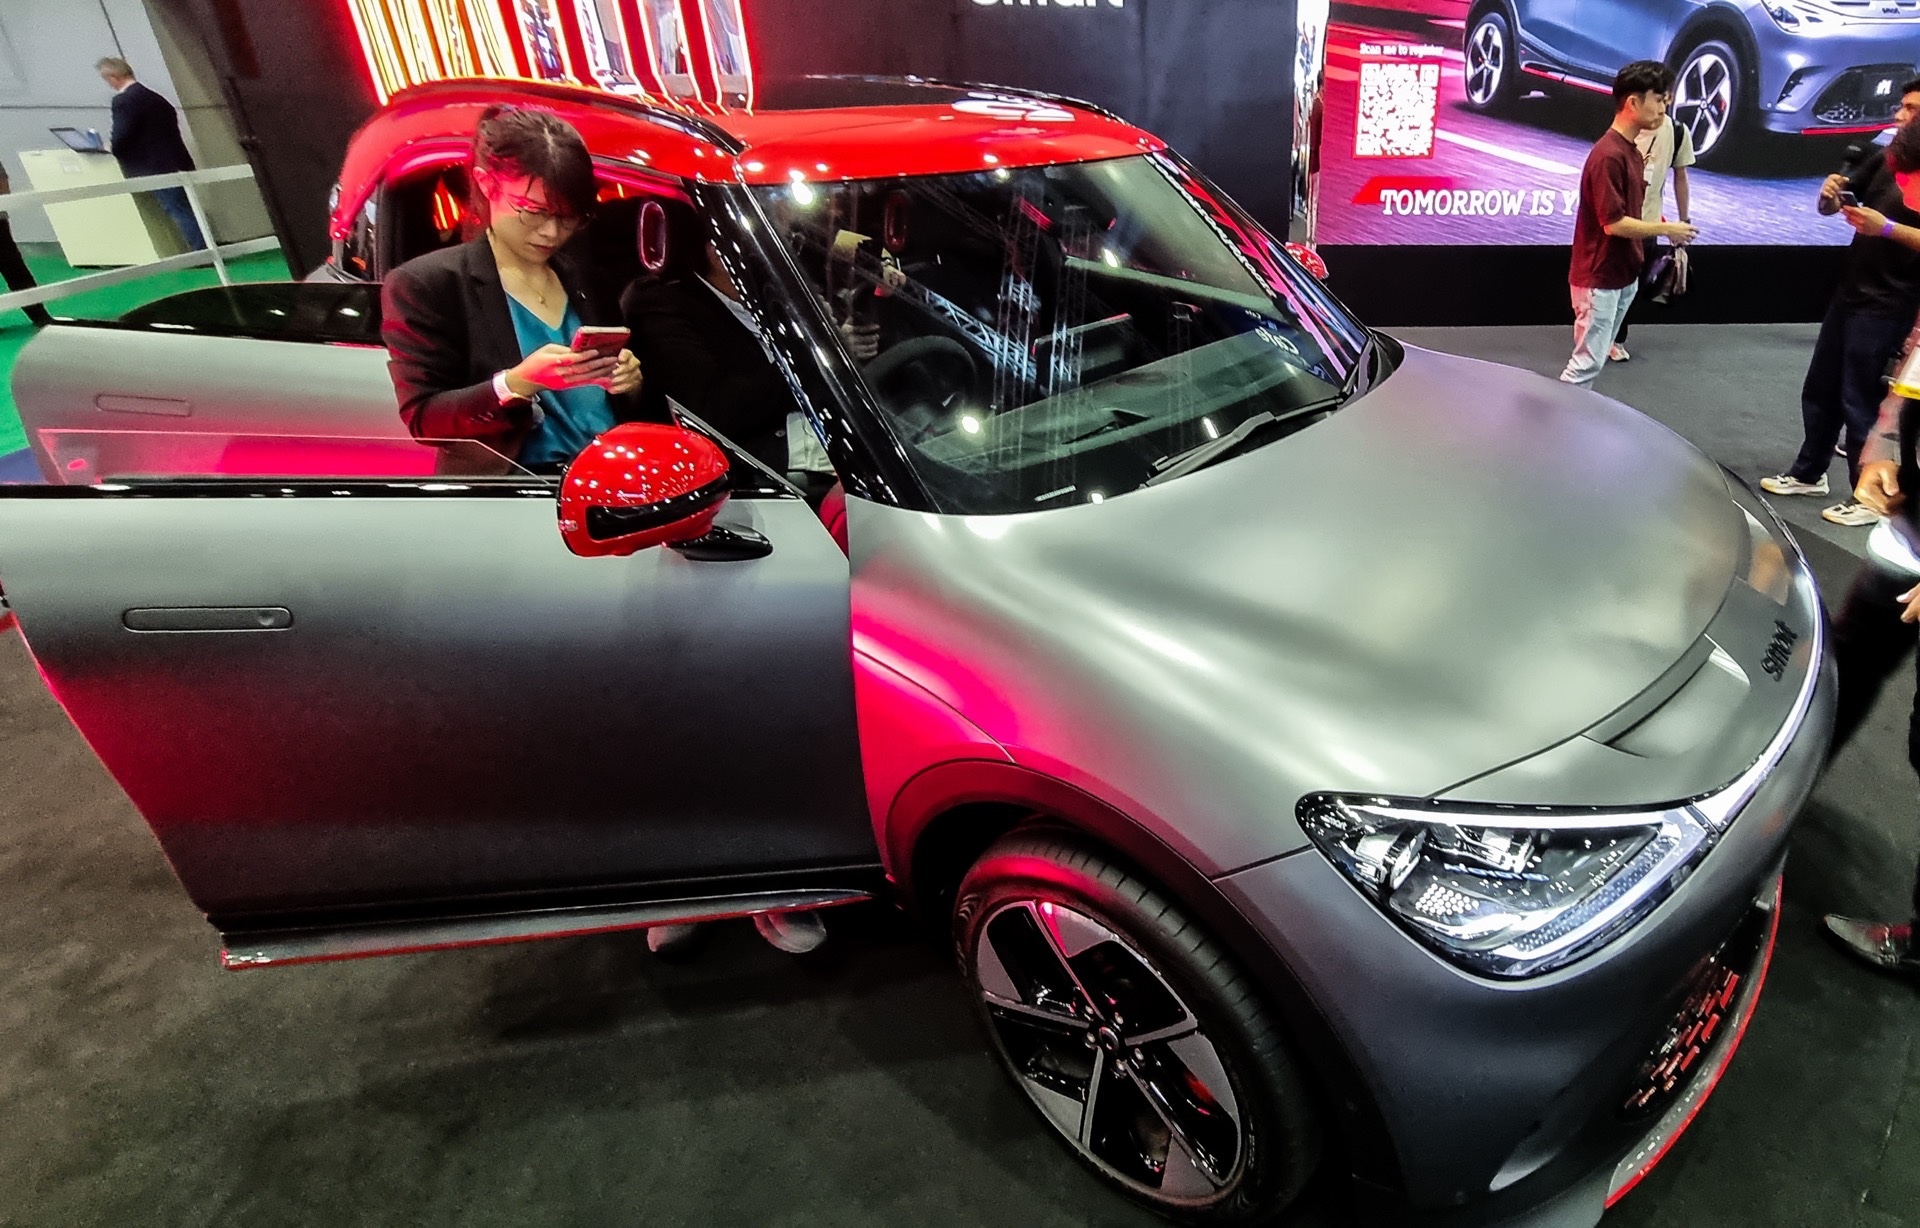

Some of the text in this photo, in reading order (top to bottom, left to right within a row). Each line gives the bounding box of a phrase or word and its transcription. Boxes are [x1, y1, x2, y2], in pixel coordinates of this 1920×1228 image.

[1360, 43, 1444, 58] Scan me to register
[1380, 189, 1525, 216] TOMORROW
[1529, 189, 1556, 216] IS
[1760, 619, 1798, 682] smart
